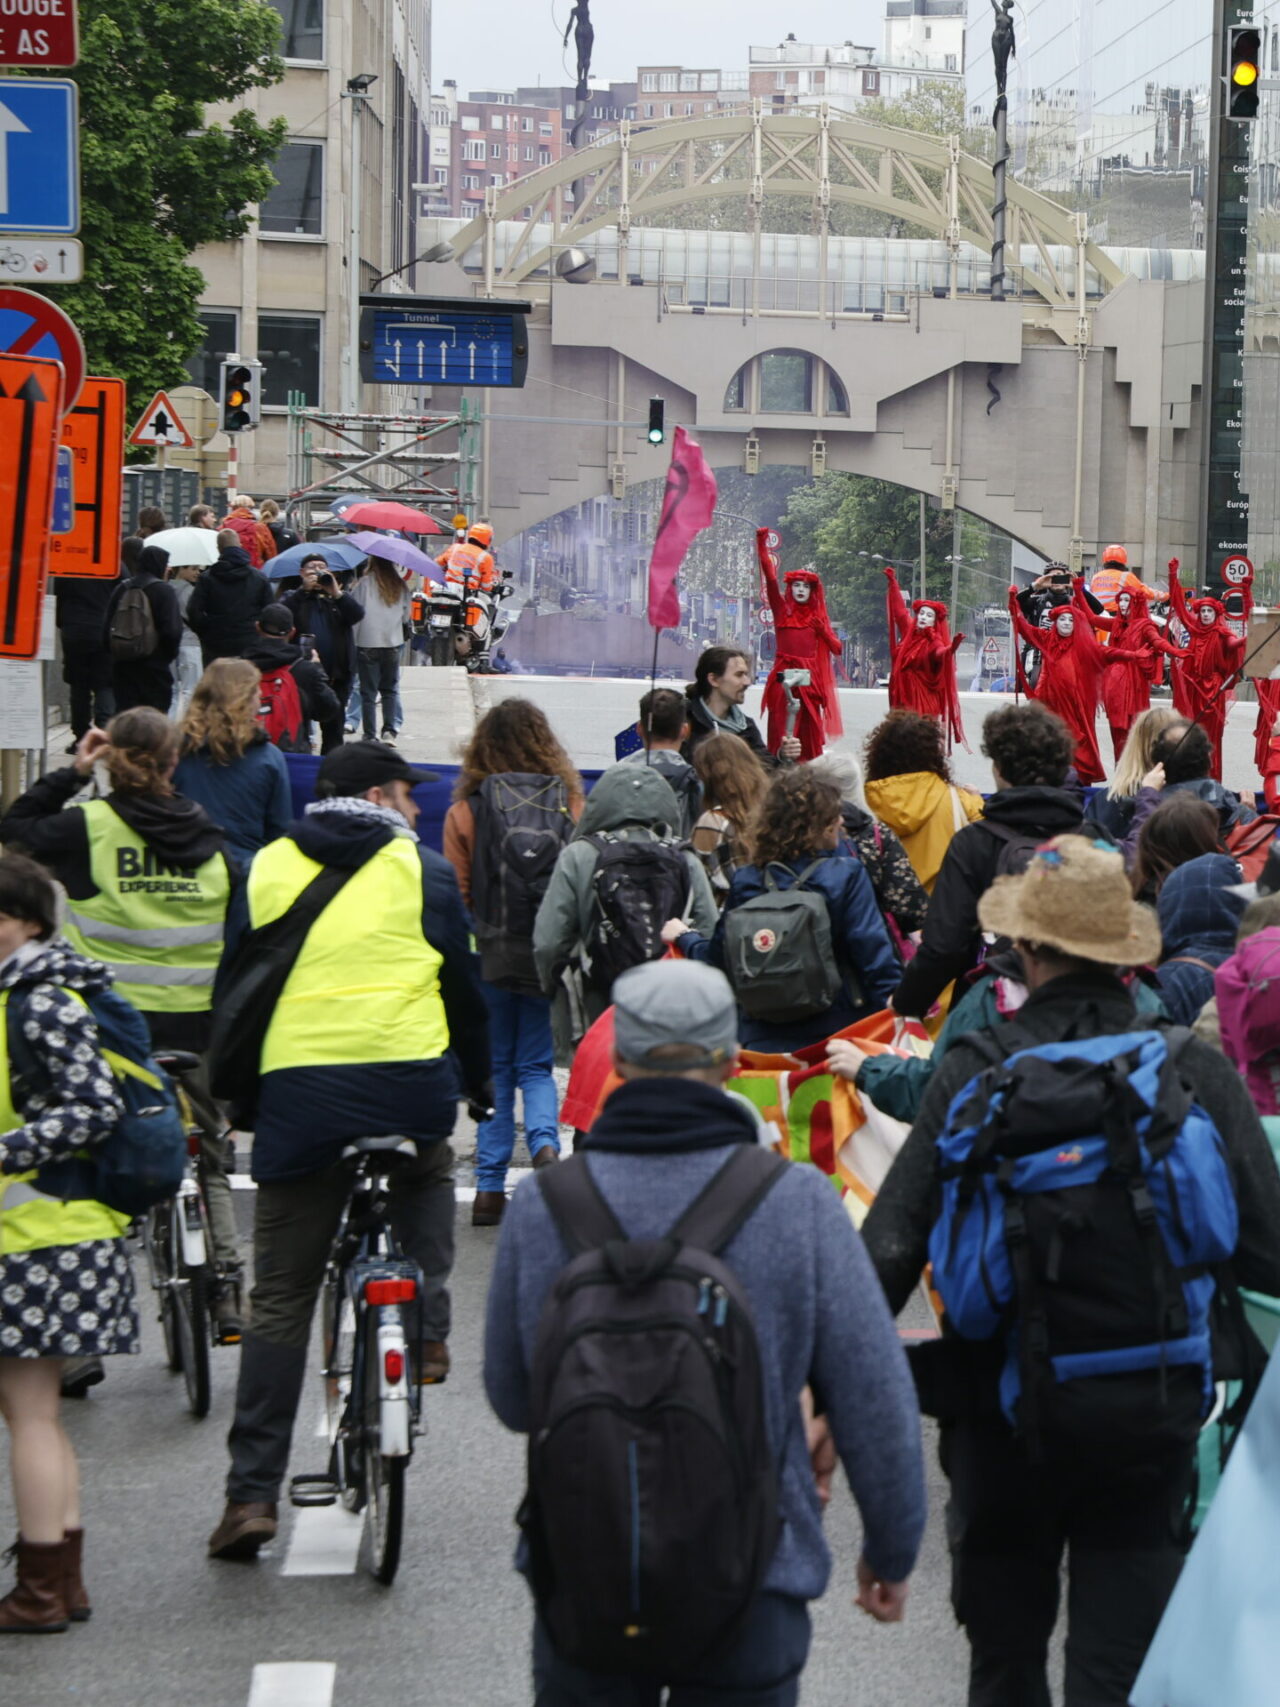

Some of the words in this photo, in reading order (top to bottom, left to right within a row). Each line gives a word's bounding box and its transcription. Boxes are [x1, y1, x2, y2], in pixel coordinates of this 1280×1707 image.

[17, 28, 50, 56] AS
[403, 313, 440, 323] Tunnel
[1228, 563, 1246, 576] 50
